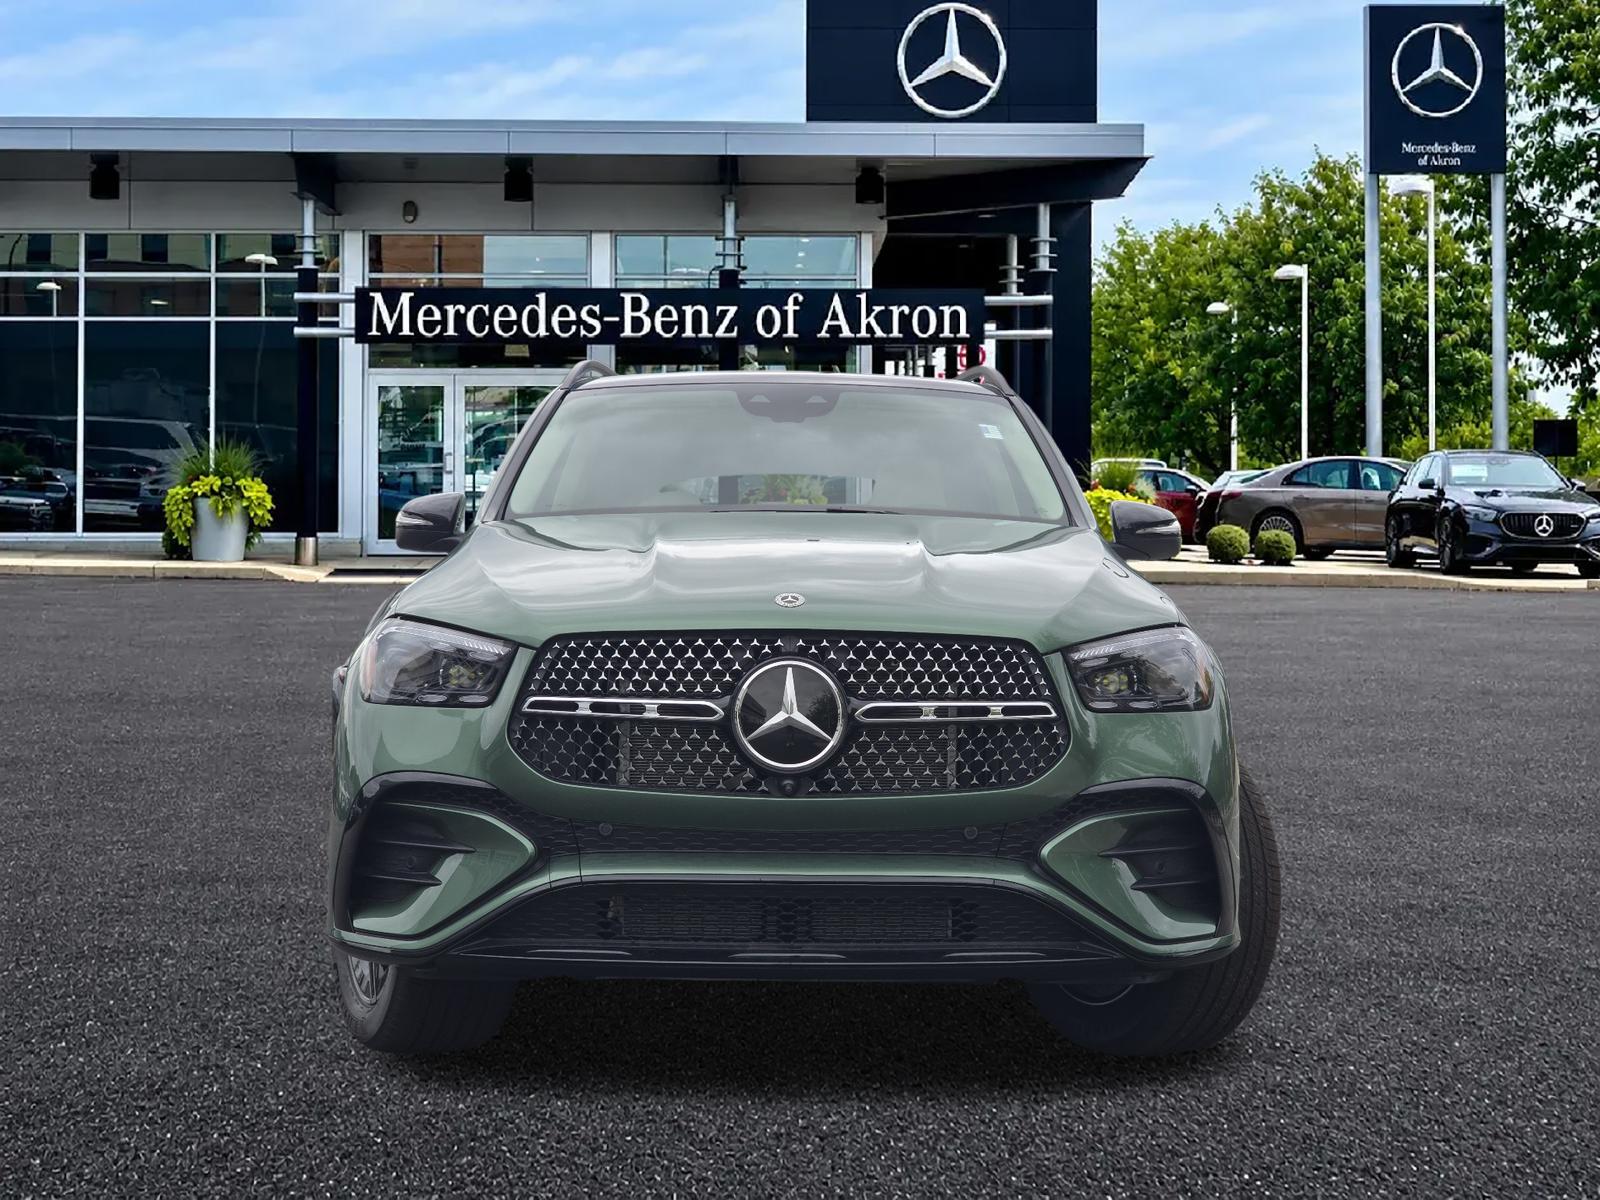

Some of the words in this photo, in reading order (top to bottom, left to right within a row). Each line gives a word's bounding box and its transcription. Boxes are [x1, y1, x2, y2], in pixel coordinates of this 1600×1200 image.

[1401, 141, 1477, 154] Mercedes-Benz
[1417, 154, 1429, 166] of
[1430, 154, 1461, 166] Akron
[367, 290, 738, 339] Mercedes-Benz
[755, 292, 804, 339] of
[816, 290, 971, 339] Akron
